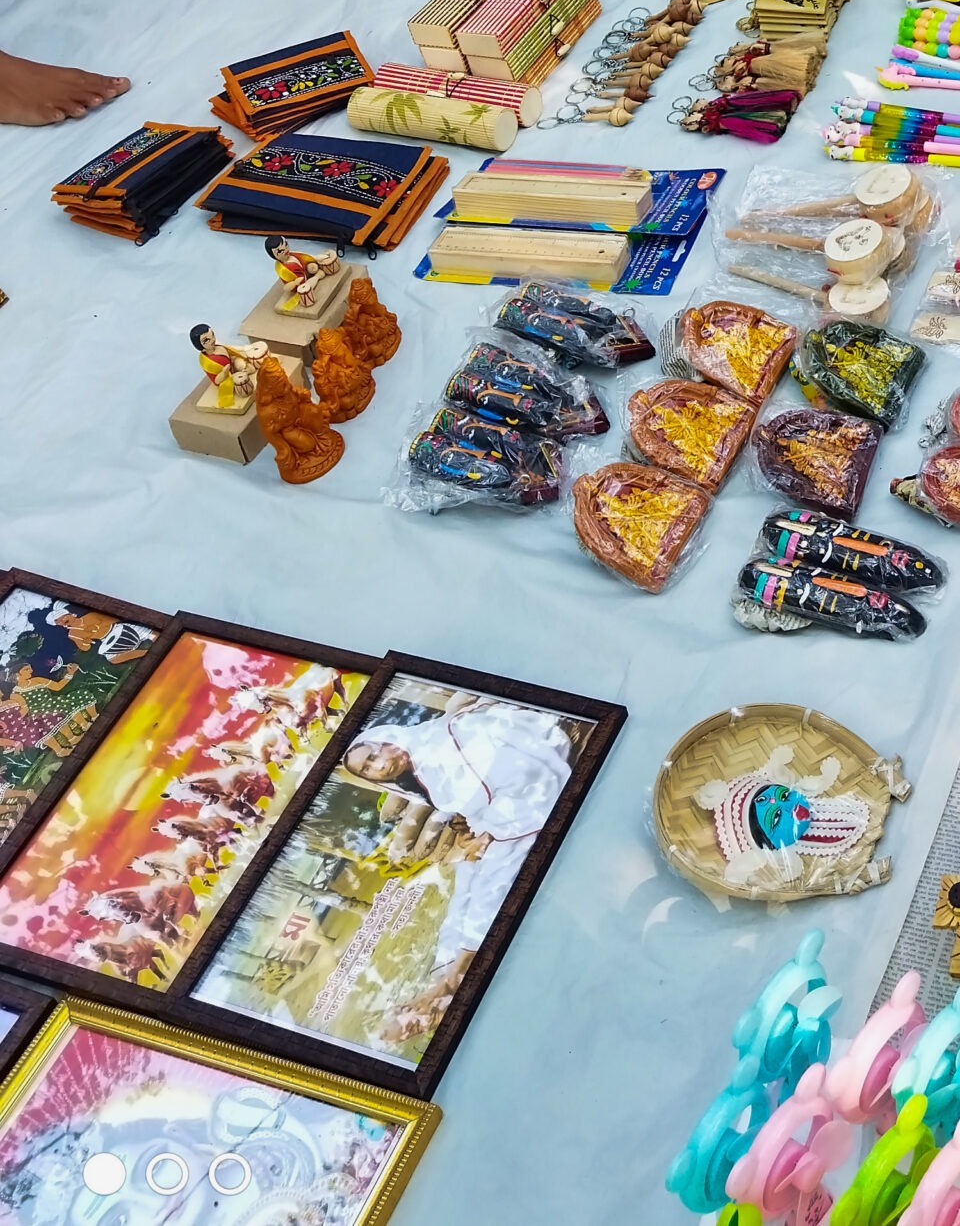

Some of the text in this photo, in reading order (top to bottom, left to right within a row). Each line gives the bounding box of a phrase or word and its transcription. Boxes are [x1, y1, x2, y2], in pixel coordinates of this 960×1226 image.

[671, 221, 681, 232] PCS
[642, 247, 657, 267] PENCIL
[644, 251, 662, 278] PENCILS
[653, 268, 671, 290] 12 PCS
